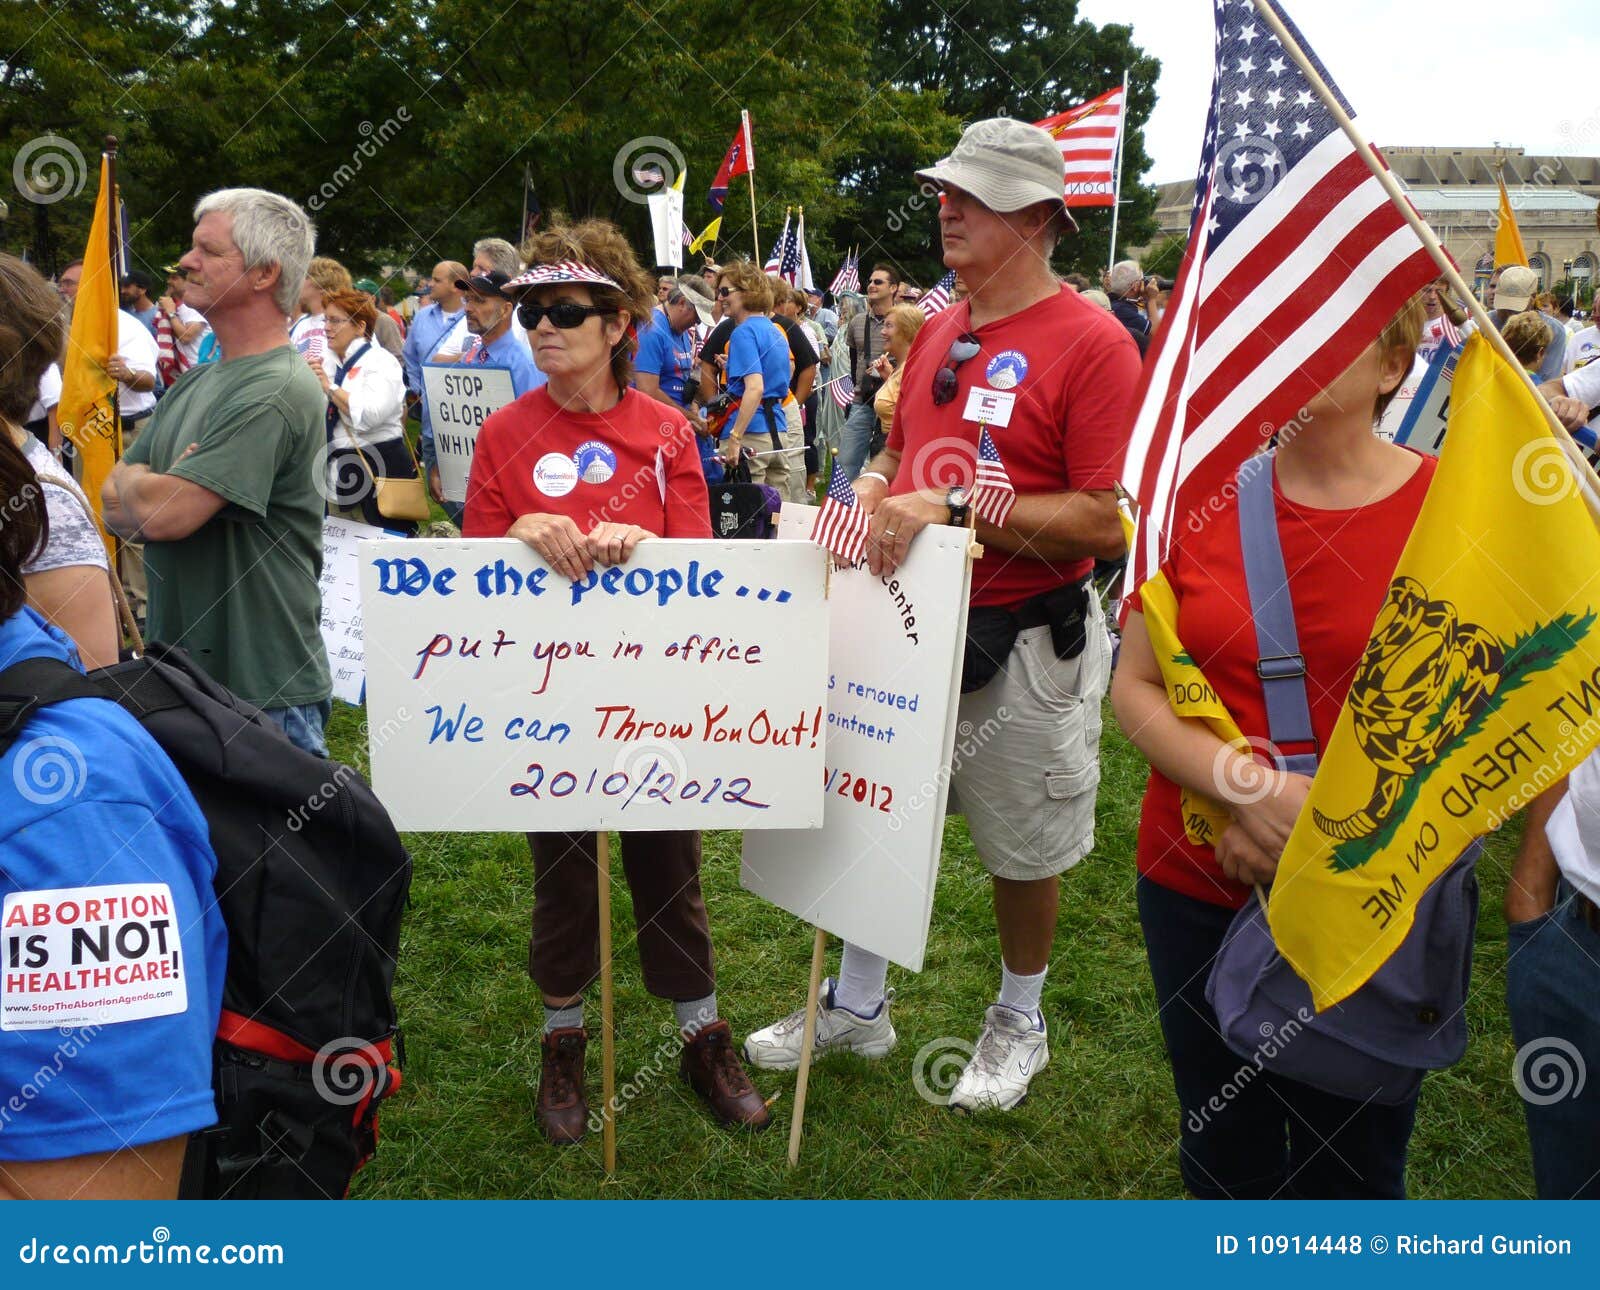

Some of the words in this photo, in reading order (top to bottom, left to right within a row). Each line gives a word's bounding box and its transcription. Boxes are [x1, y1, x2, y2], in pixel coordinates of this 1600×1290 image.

[445, 374, 483, 397] STOP
[440, 401, 499, 427] GLOB
[590, 441, 613, 456] HOUSE
[373, 557, 456, 596] We
[474, 559, 548, 597] the
[413, 630, 516, 680] put
[532, 639, 596, 695] you
[612, 631, 643, 661] in
[664, 636, 763, 664] office
[848, 681, 919, 712] removed
[424, 703, 485, 745] We
[504, 715, 572, 744] can
[595, 704, 693, 740] Throw
[748, 705, 822, 748] Out!
[509, 759, 771, 810] 2010/2012
[5, 895, 169, 927] ABORTION
[9, 935, 49, 968] IS
[71, 919, 170, 965] NOT
[5, 990, 173, 1012] www.StopTheAbortionAgenda.com
